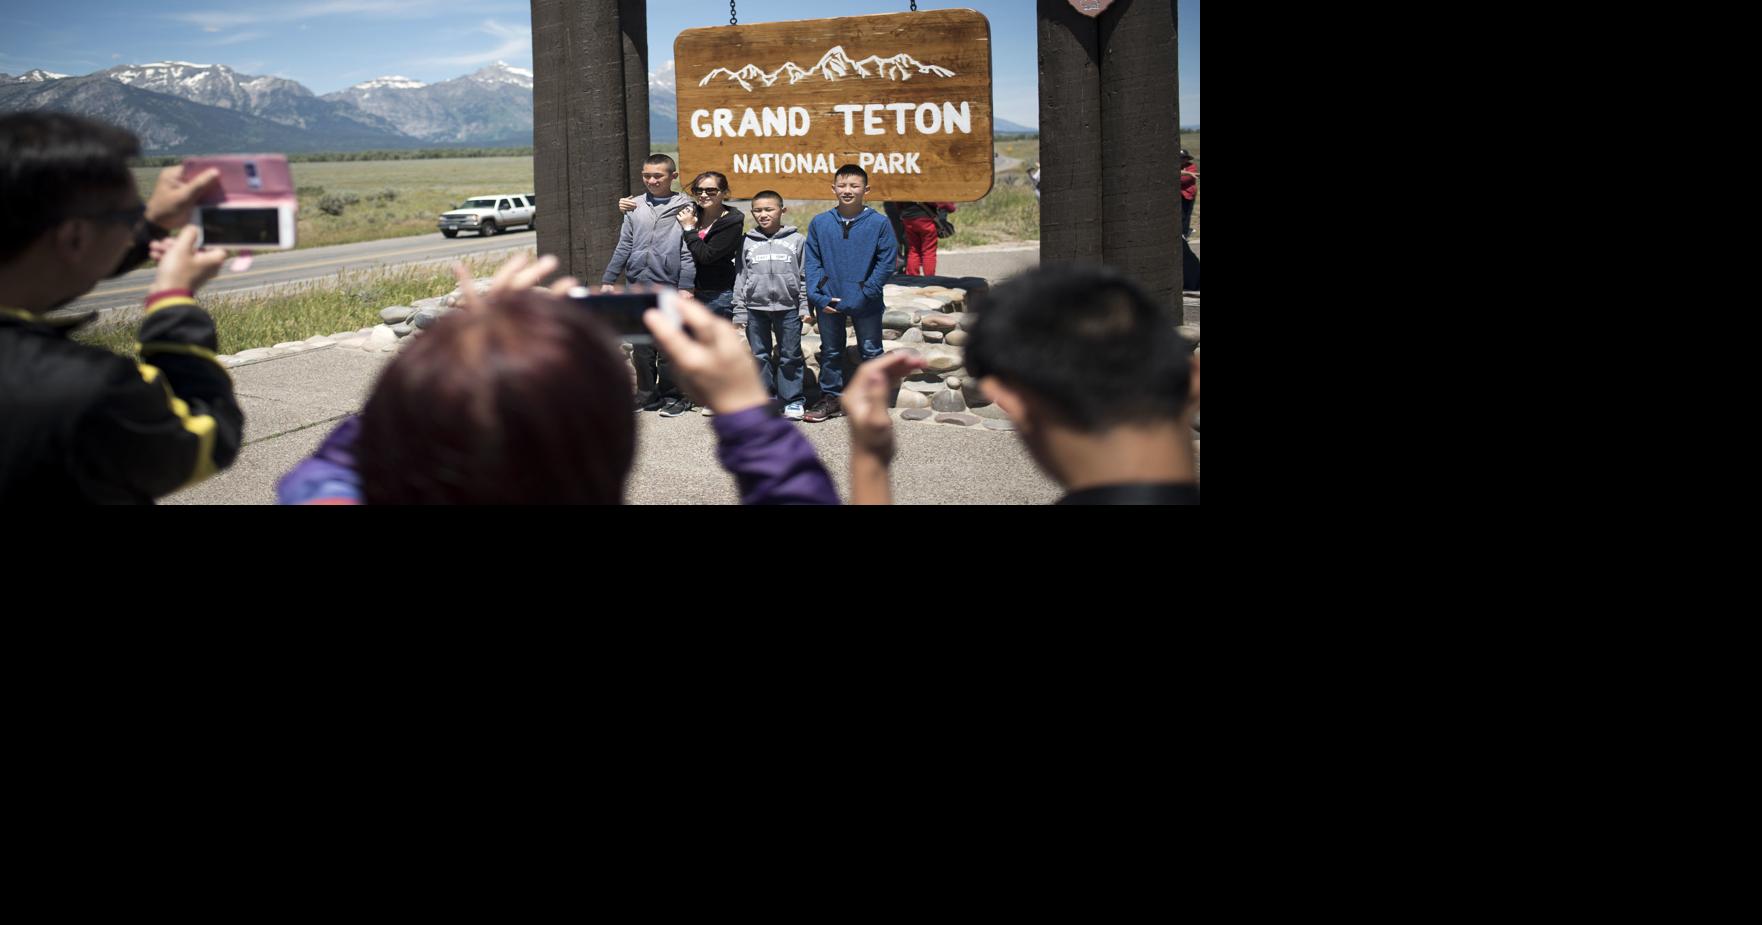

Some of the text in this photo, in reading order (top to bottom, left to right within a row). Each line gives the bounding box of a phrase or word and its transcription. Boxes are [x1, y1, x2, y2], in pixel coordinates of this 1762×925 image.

[690, 101, 972, 138] GRAND TETON
[733, 152, 921, 174] NATIONAL PARK
